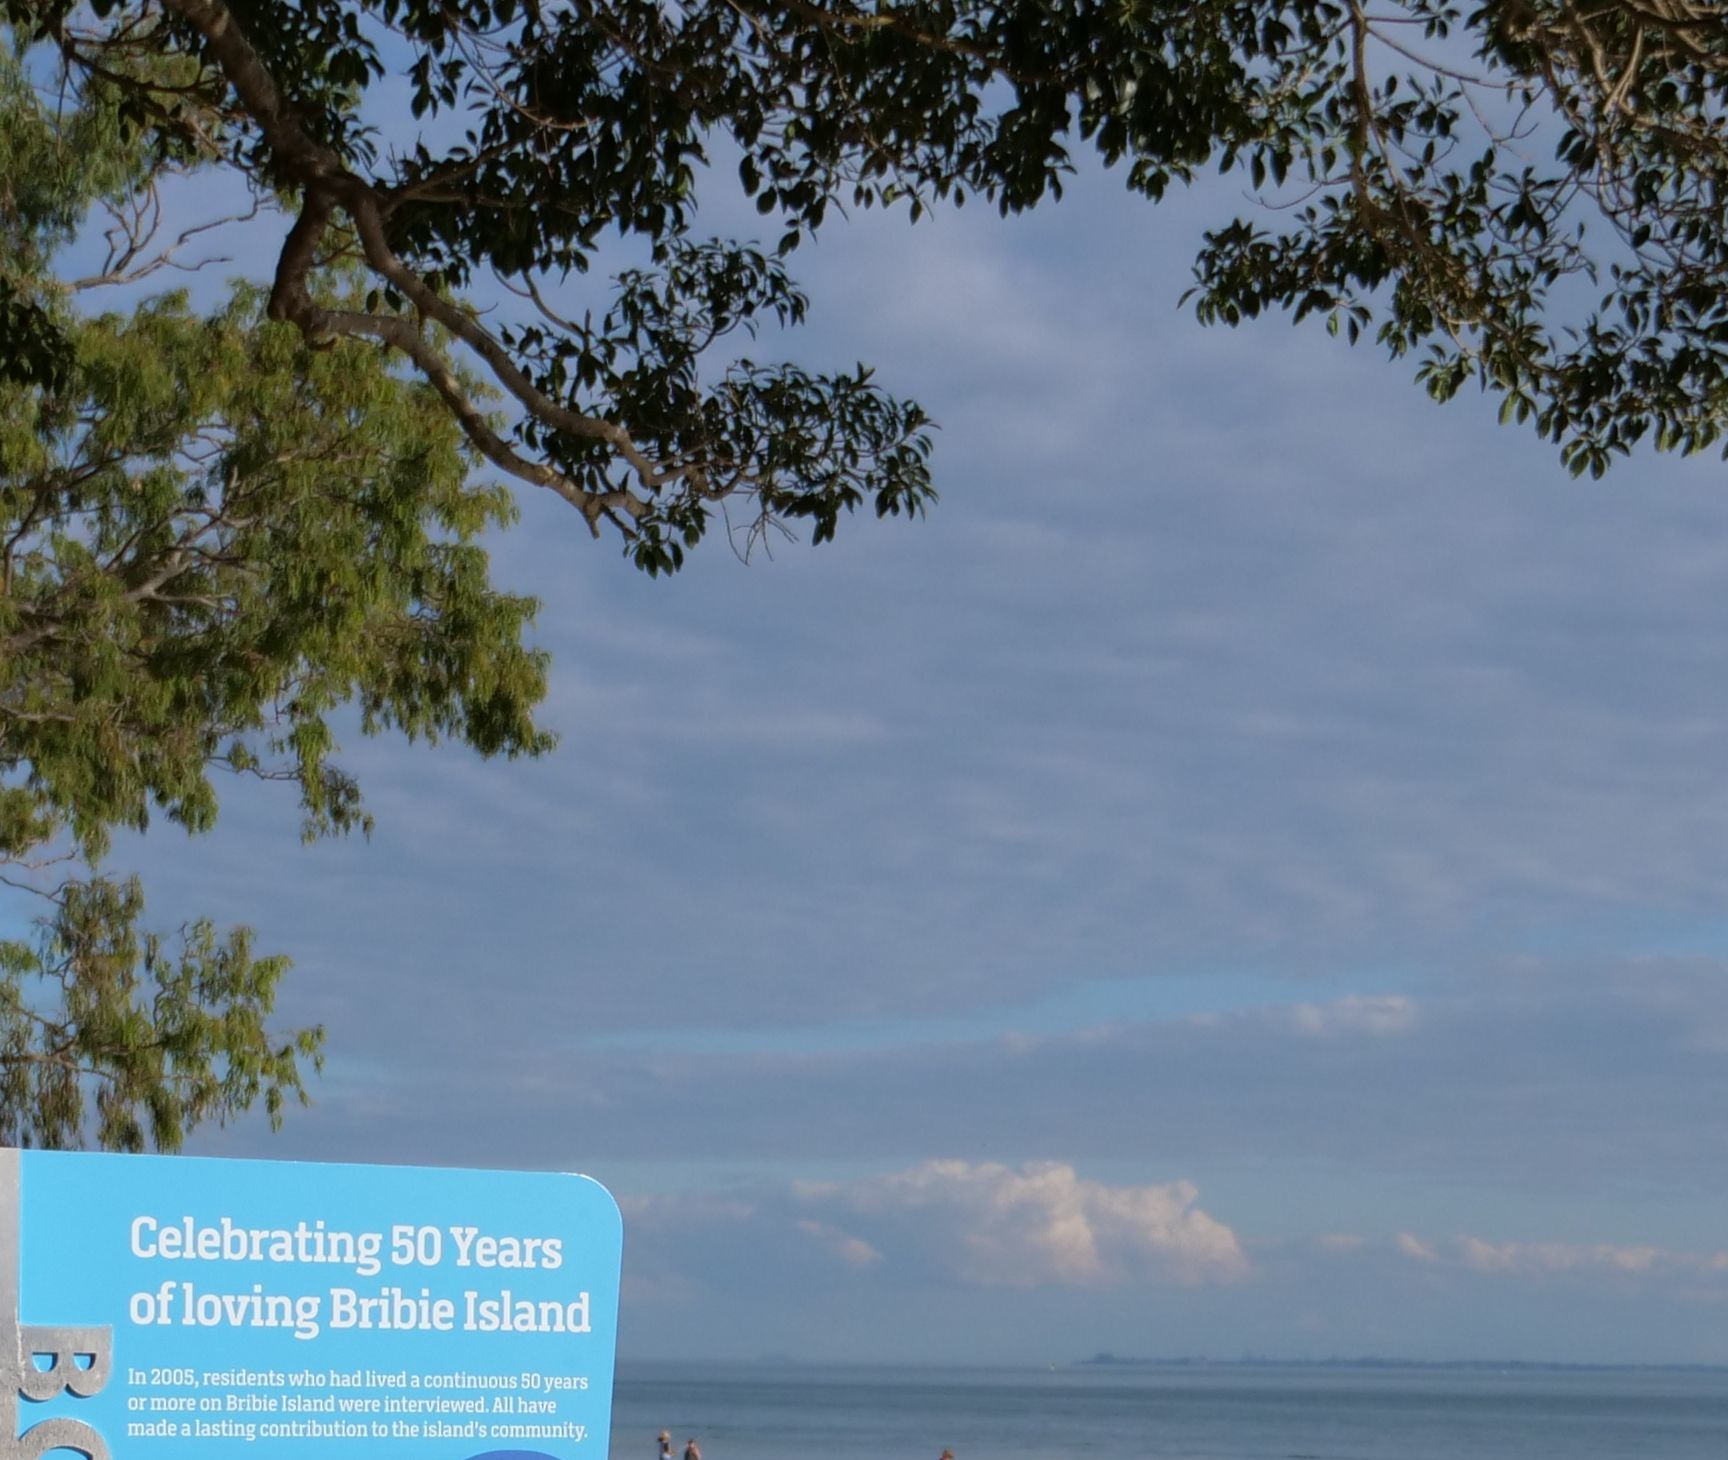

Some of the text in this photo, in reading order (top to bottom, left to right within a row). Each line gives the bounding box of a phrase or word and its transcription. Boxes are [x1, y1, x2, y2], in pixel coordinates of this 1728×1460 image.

[131, 1215, 562, 1276] Celebrating 50 Years
[129, 1280, 591, 1339] of loving Bribie Island
[128, 1368, 588, 1393] In 2005, residents who had lived a continuous 50 years
[127, 1394, 556, 1413] or more on Bribie Island were interviewed. All have
[127, 1419, 587, 1442] made a lasting contribution to the island's community.
